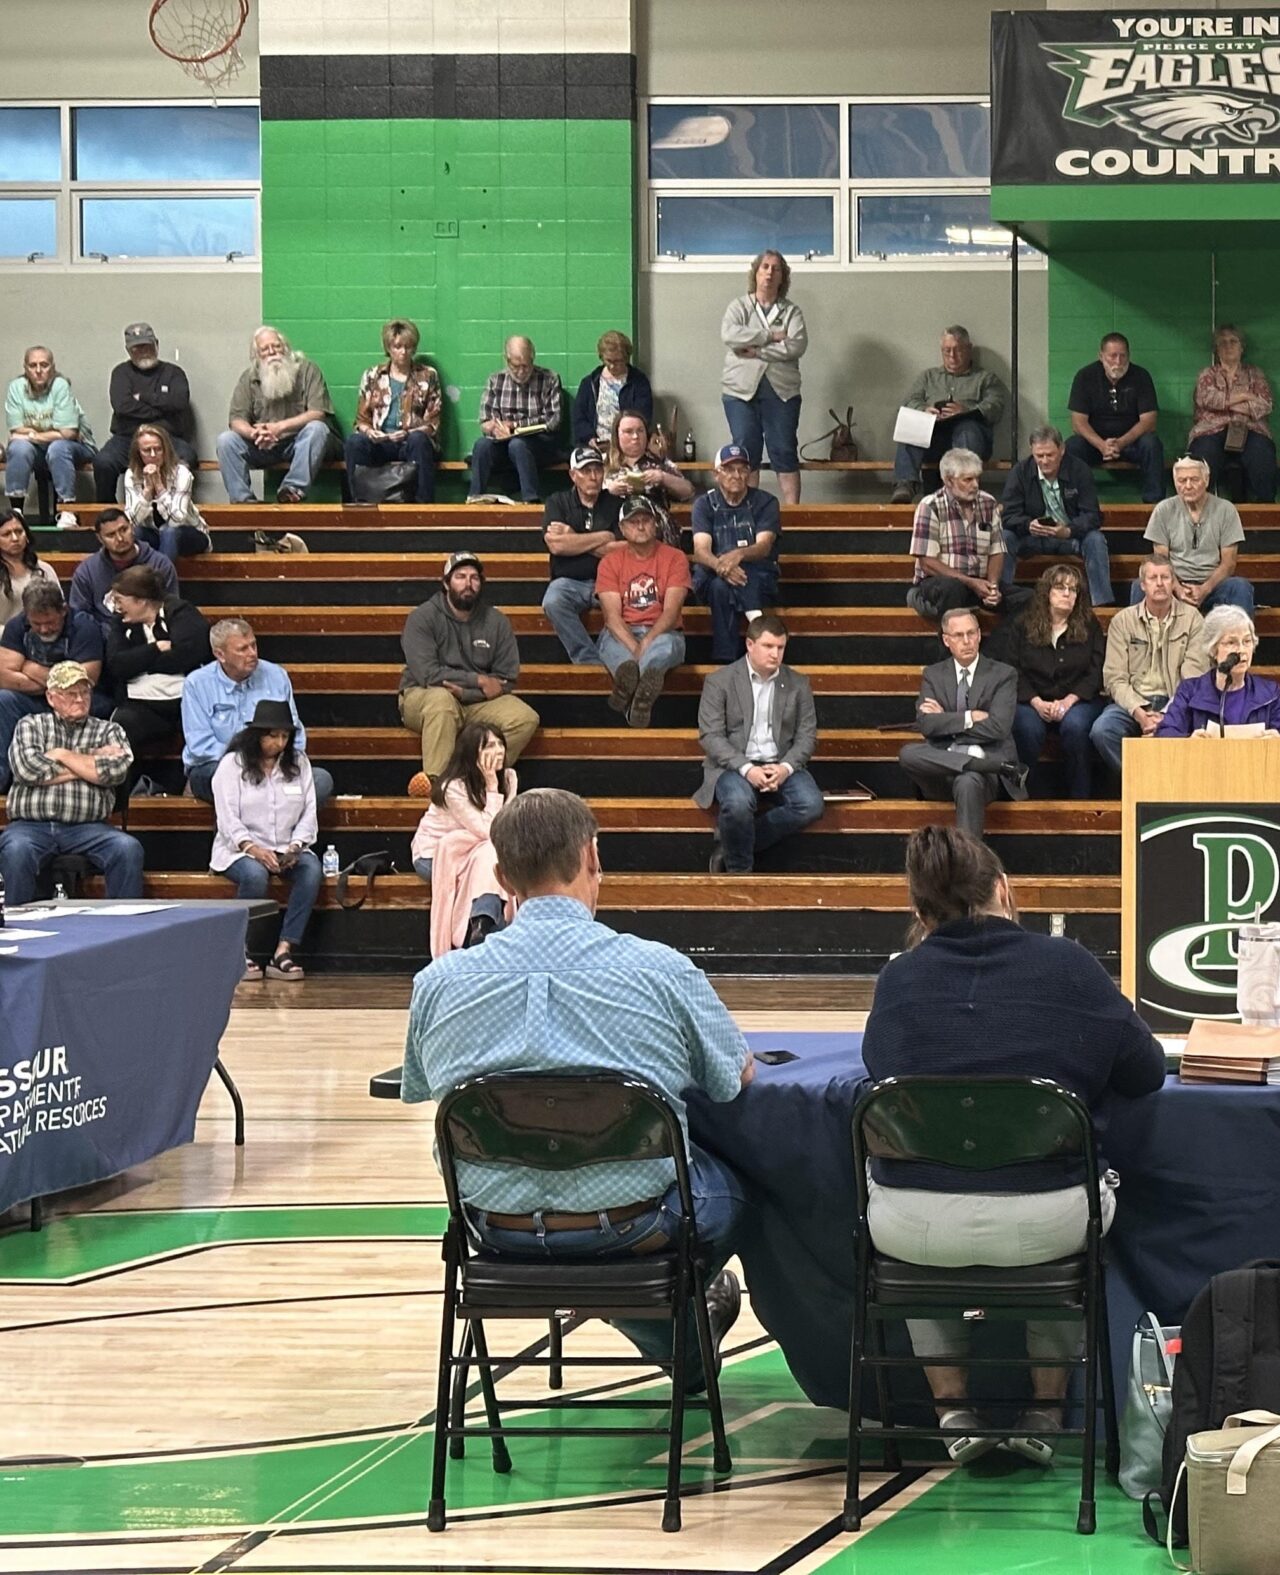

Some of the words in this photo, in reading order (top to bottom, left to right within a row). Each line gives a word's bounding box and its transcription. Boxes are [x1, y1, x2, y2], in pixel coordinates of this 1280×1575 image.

[1113, 18, 1234, 38] YOU'RE
[1242, 16, 1280, 36] IN
[1143, 43, 1209, 51] PIERCE
[1215, 42, 1257, 50] CITY
